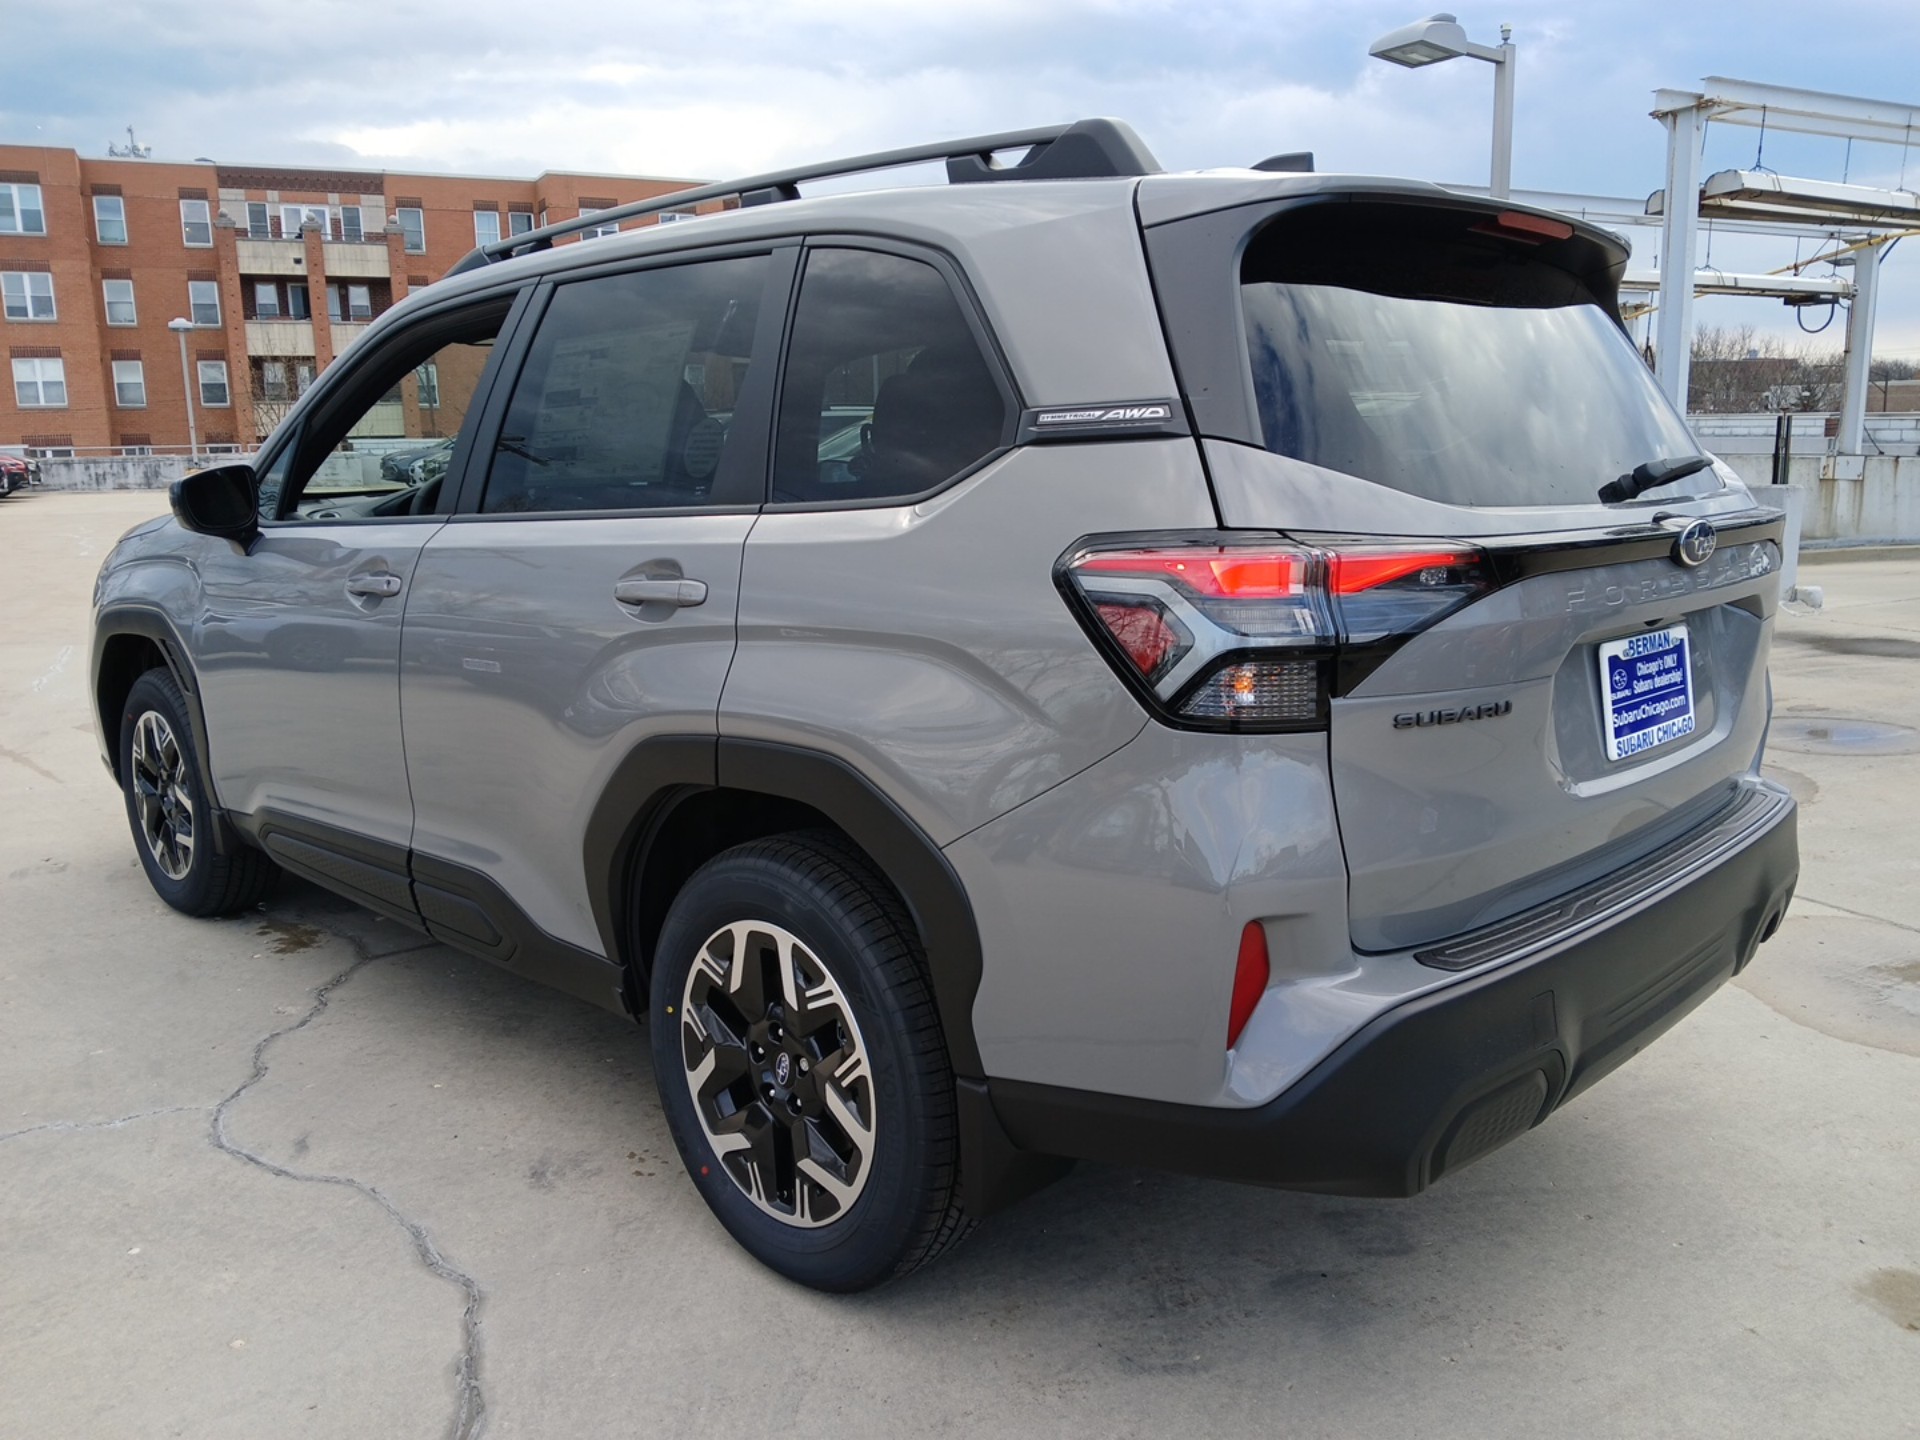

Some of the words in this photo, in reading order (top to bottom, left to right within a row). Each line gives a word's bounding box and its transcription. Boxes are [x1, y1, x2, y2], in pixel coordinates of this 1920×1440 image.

[1101, 407, 1166, 421] AWD
[1628, 631, 1670, 656] BERMAN
[1636, 658, 1664, 677] Chicago's
[1664, 653, 1678, 669] ONLY
[1633, 679, 1654, 694] Subaru
[1393, 700, 1513, 729] SUBARU
[1613, 695, 1686, 728] SubaruChicago.com
[1616, 733, 1655, 758] SUBARU
[1656, 716, 1694, 743] CHICAGO
